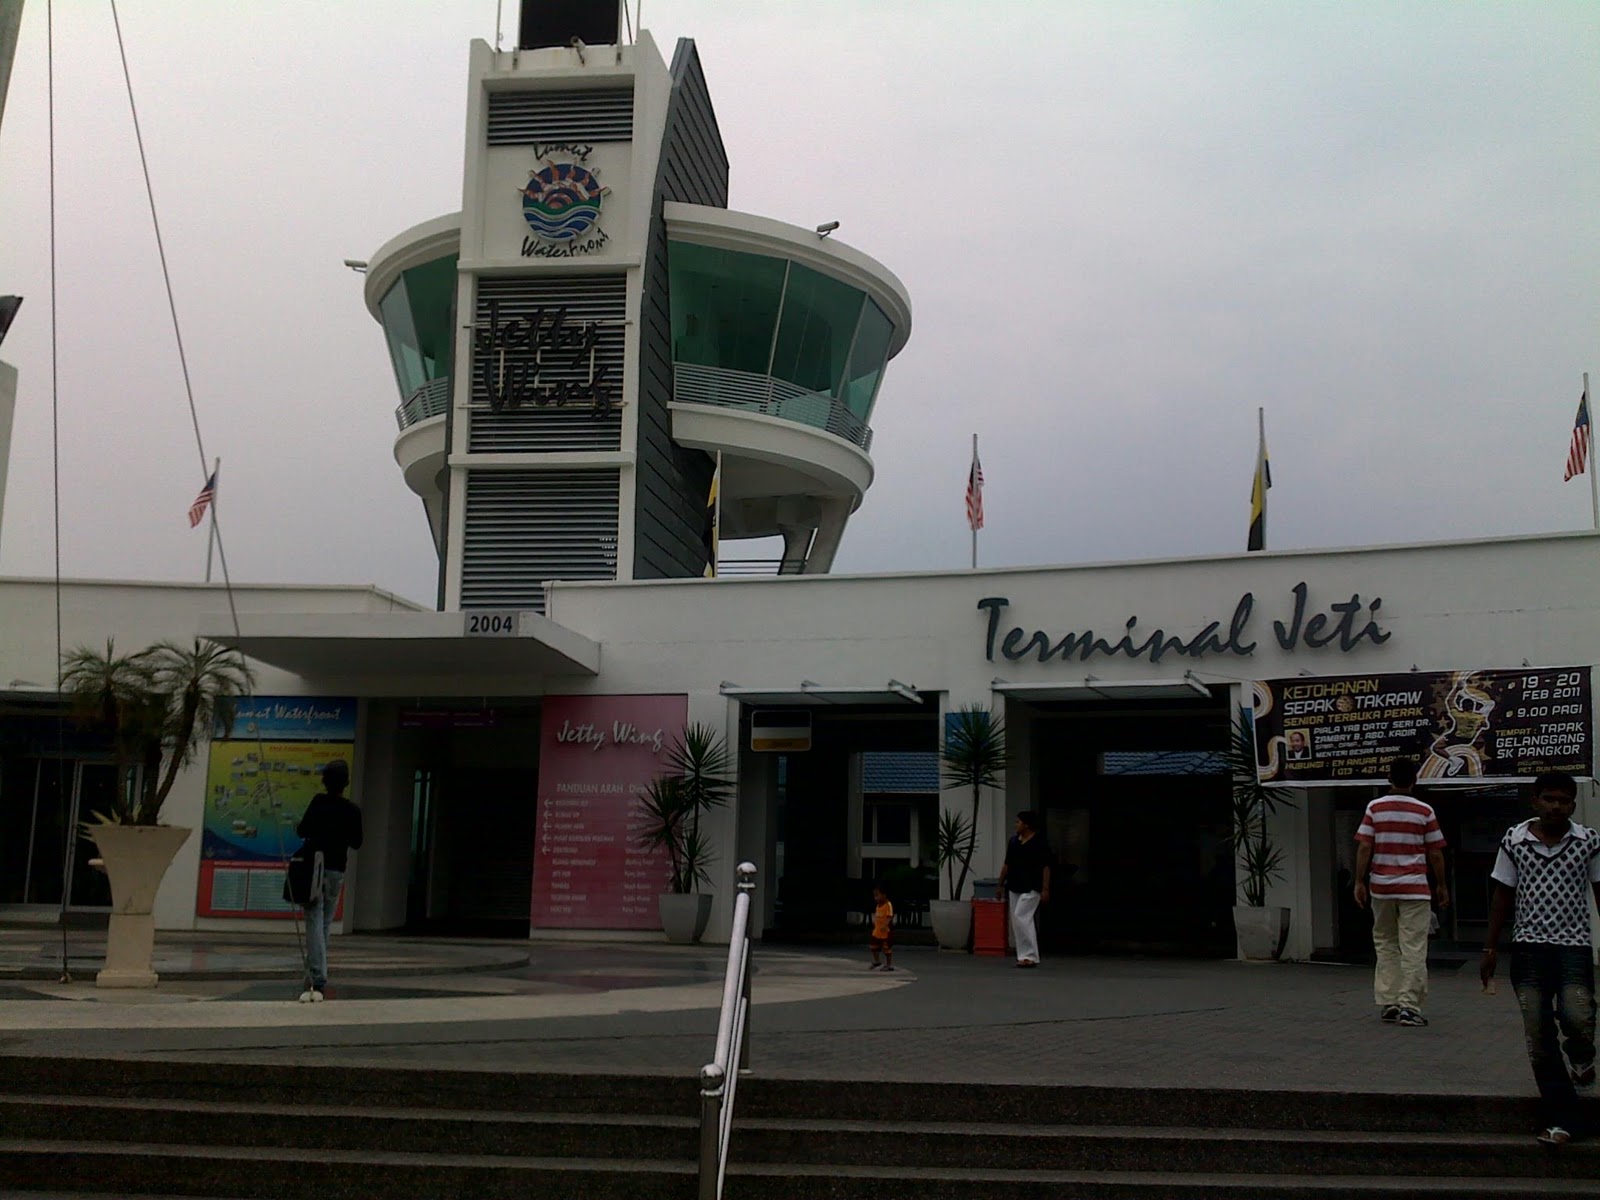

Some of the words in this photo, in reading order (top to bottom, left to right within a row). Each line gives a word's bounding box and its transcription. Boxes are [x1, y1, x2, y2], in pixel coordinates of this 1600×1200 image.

[520, 228, 610, 258] Waterfront
[476, 300, 602, 370] Jetty
[470, 615, 512, 632] 2004
[977, 592, 1257, 664] Terminal
[1273, 581, 1392, 653] Jeti
[1521, 676, 1539, 689] 19
[1556, 672, 1581, 687] 20
[1283, 679, 1379, 700] KEJOHANAN
[1522, 690, 1549, 701] FEB
[1552, 686, 1581, 698] 2011
[1283, 698, 1336, 716] SEPAK
[1355, 690, 1423, 709] TAKRAW
[1517, 707, 1548, 718] 9.00
[1552, 704, 1583, 716] PAGI
[233, 704, 271, 719] umut
[274, 703, 343, 725] Waterfront
[1283, 715, 1324, 727] SENIOR
[1328, 710, 1381, 723] TERBUKA
[1384, 707, 1424, 719] PERAK
[557, 719, 606, 751] Jetty
[613, 719, 663, 752] Wing
[1313, 725, 1341, 735] PIALA
[1392, 720, 1414, 729] SERI
[1314, 733, 1352, 744] ZAMBRY
[1388, 728, 1417, 738] KADIR
[1495, 727, 1532, 737] TEMPAT
[1540, 721, 1584, 734] TAPAK
[1496, 733, 1585, 748] GELANGGANG
[1496, 749, 1514, 759] SK
[1517, 744, 1580, 757] PANGKOR
[556, 783, 598, 793] PANDUAN
[600, 783, 623, 793] ARAH
